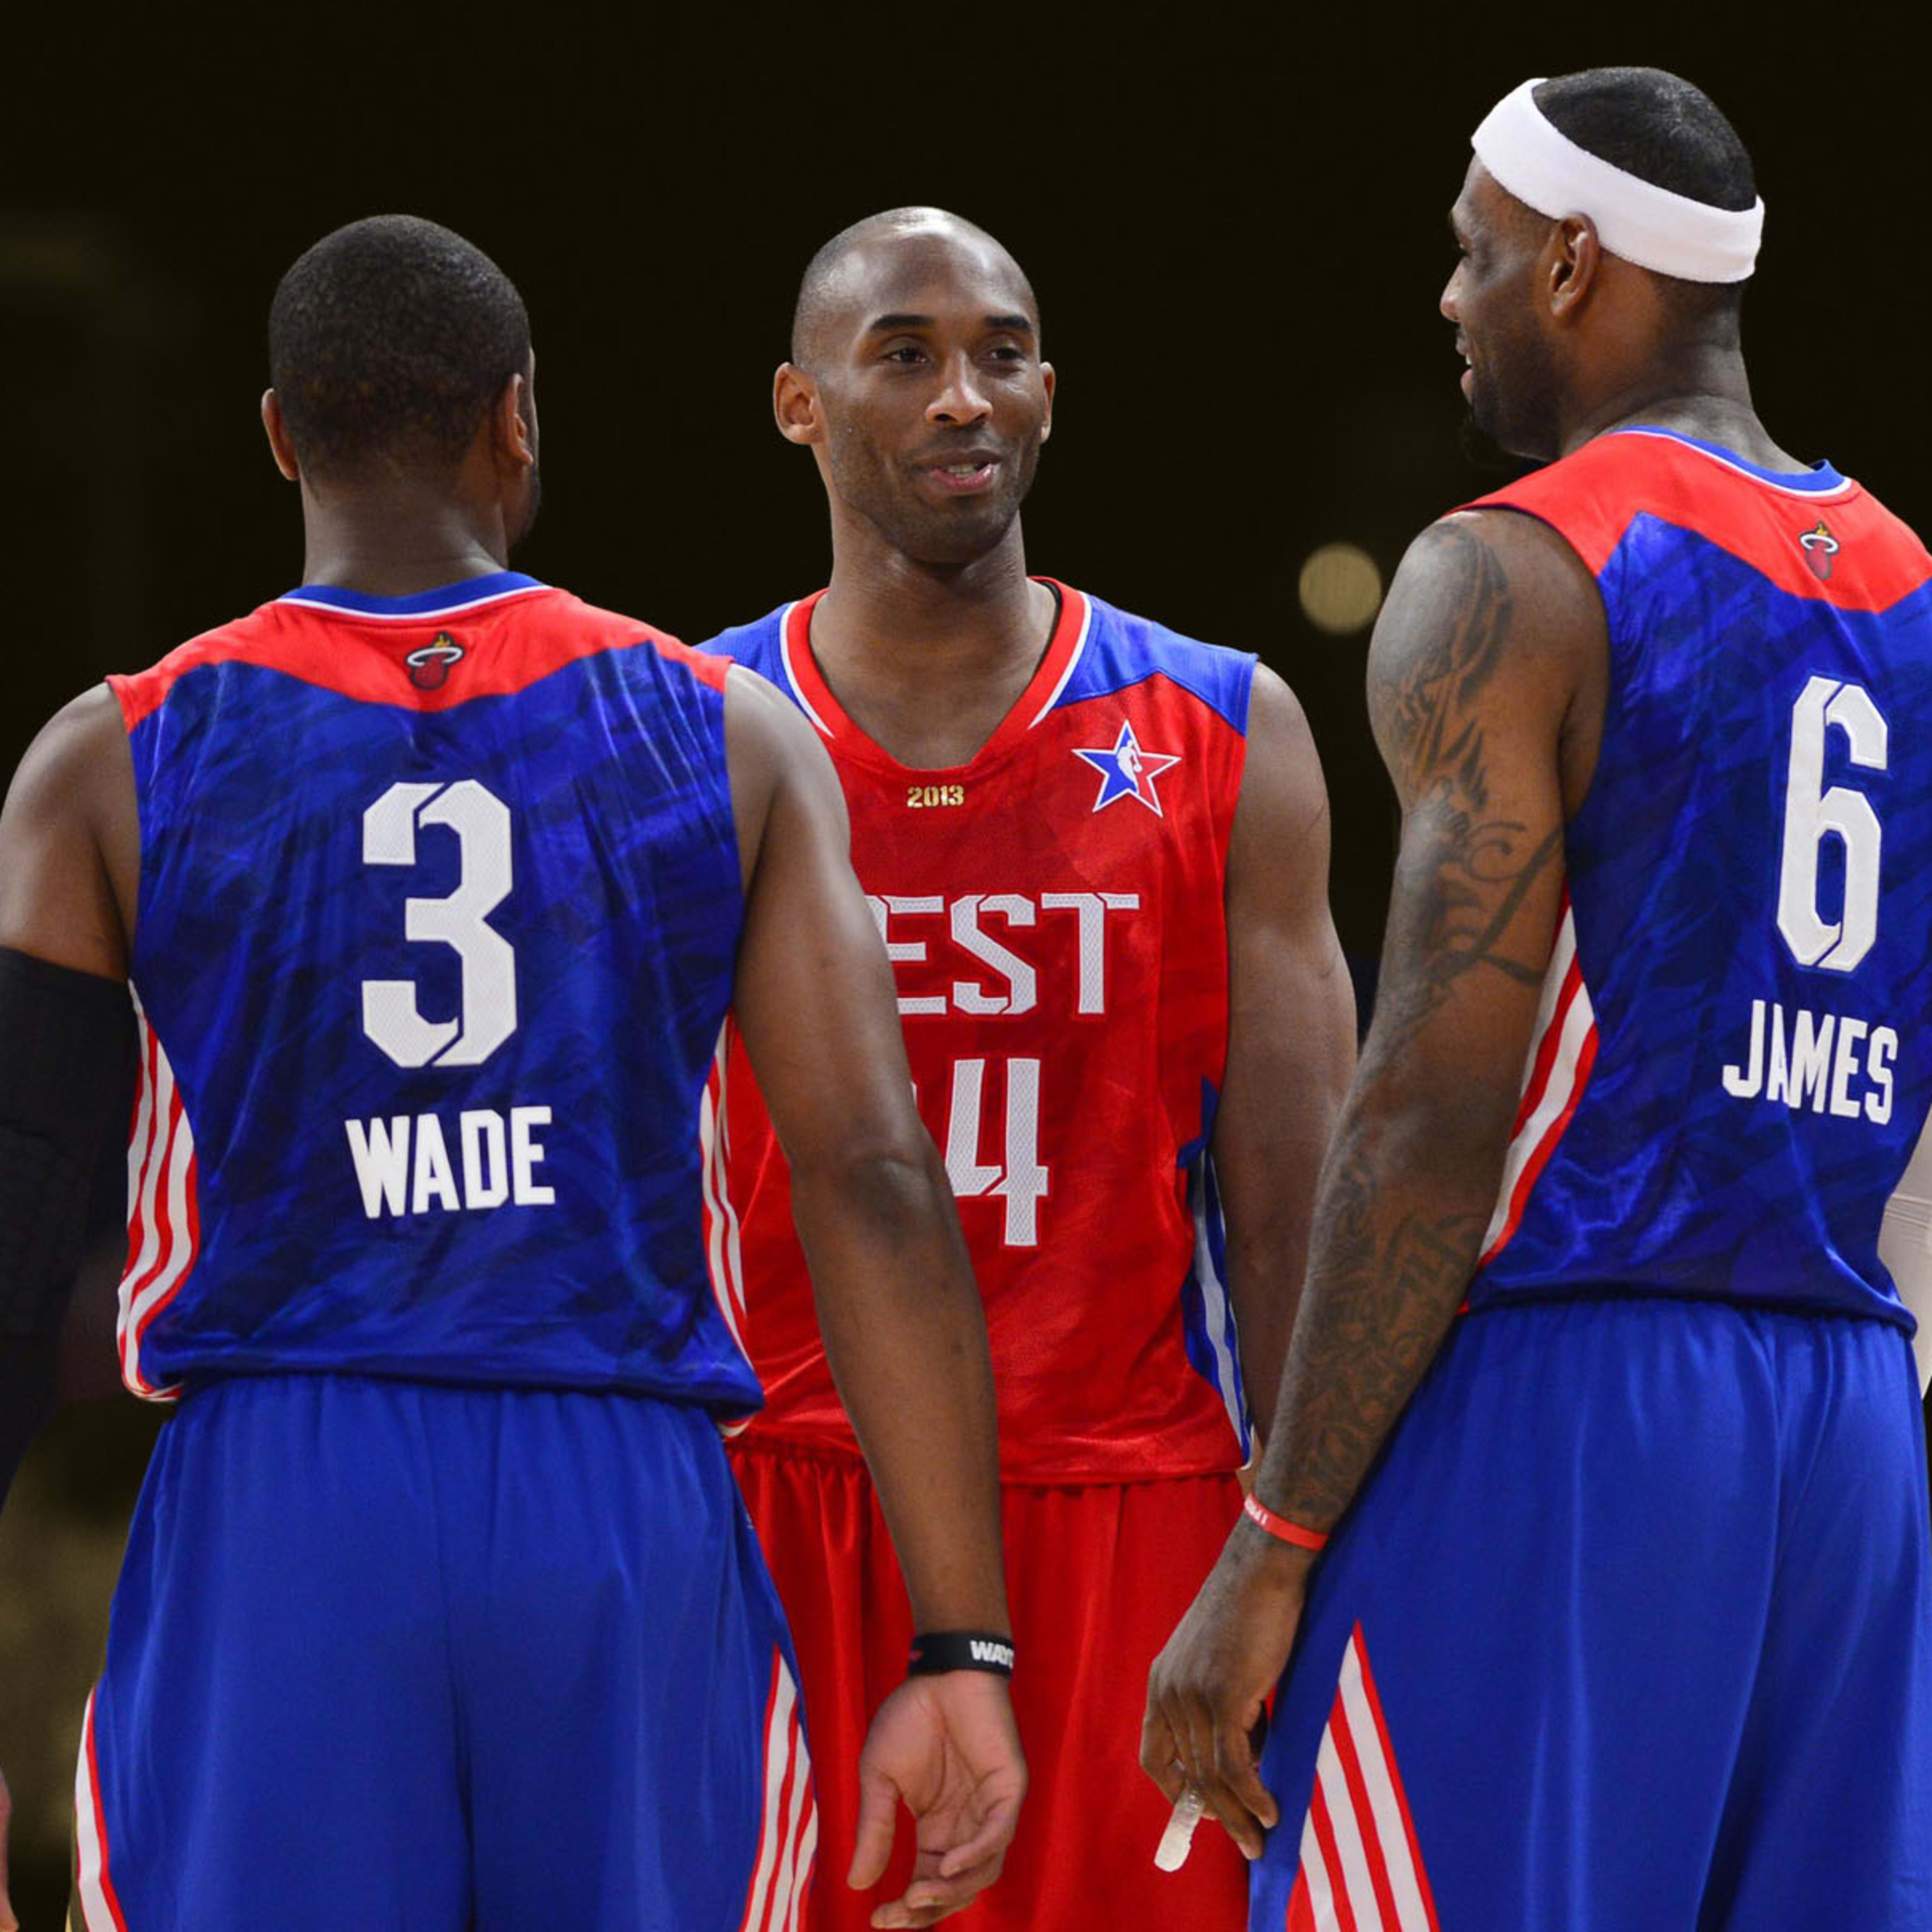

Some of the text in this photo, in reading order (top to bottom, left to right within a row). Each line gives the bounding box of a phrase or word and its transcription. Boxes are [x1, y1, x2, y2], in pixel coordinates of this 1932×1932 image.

[907, 785, 964, 808] 2013
[1777, 676, 1888, 972] 6
[362, 779, 517, 1067] 3
[864, 893, 1139, 1014] EST
[1722, 999, 1898, 1125] JAMES
[345, 1106, 555, 1219] WADE
[912, 1058, 1048, 1246] 4
